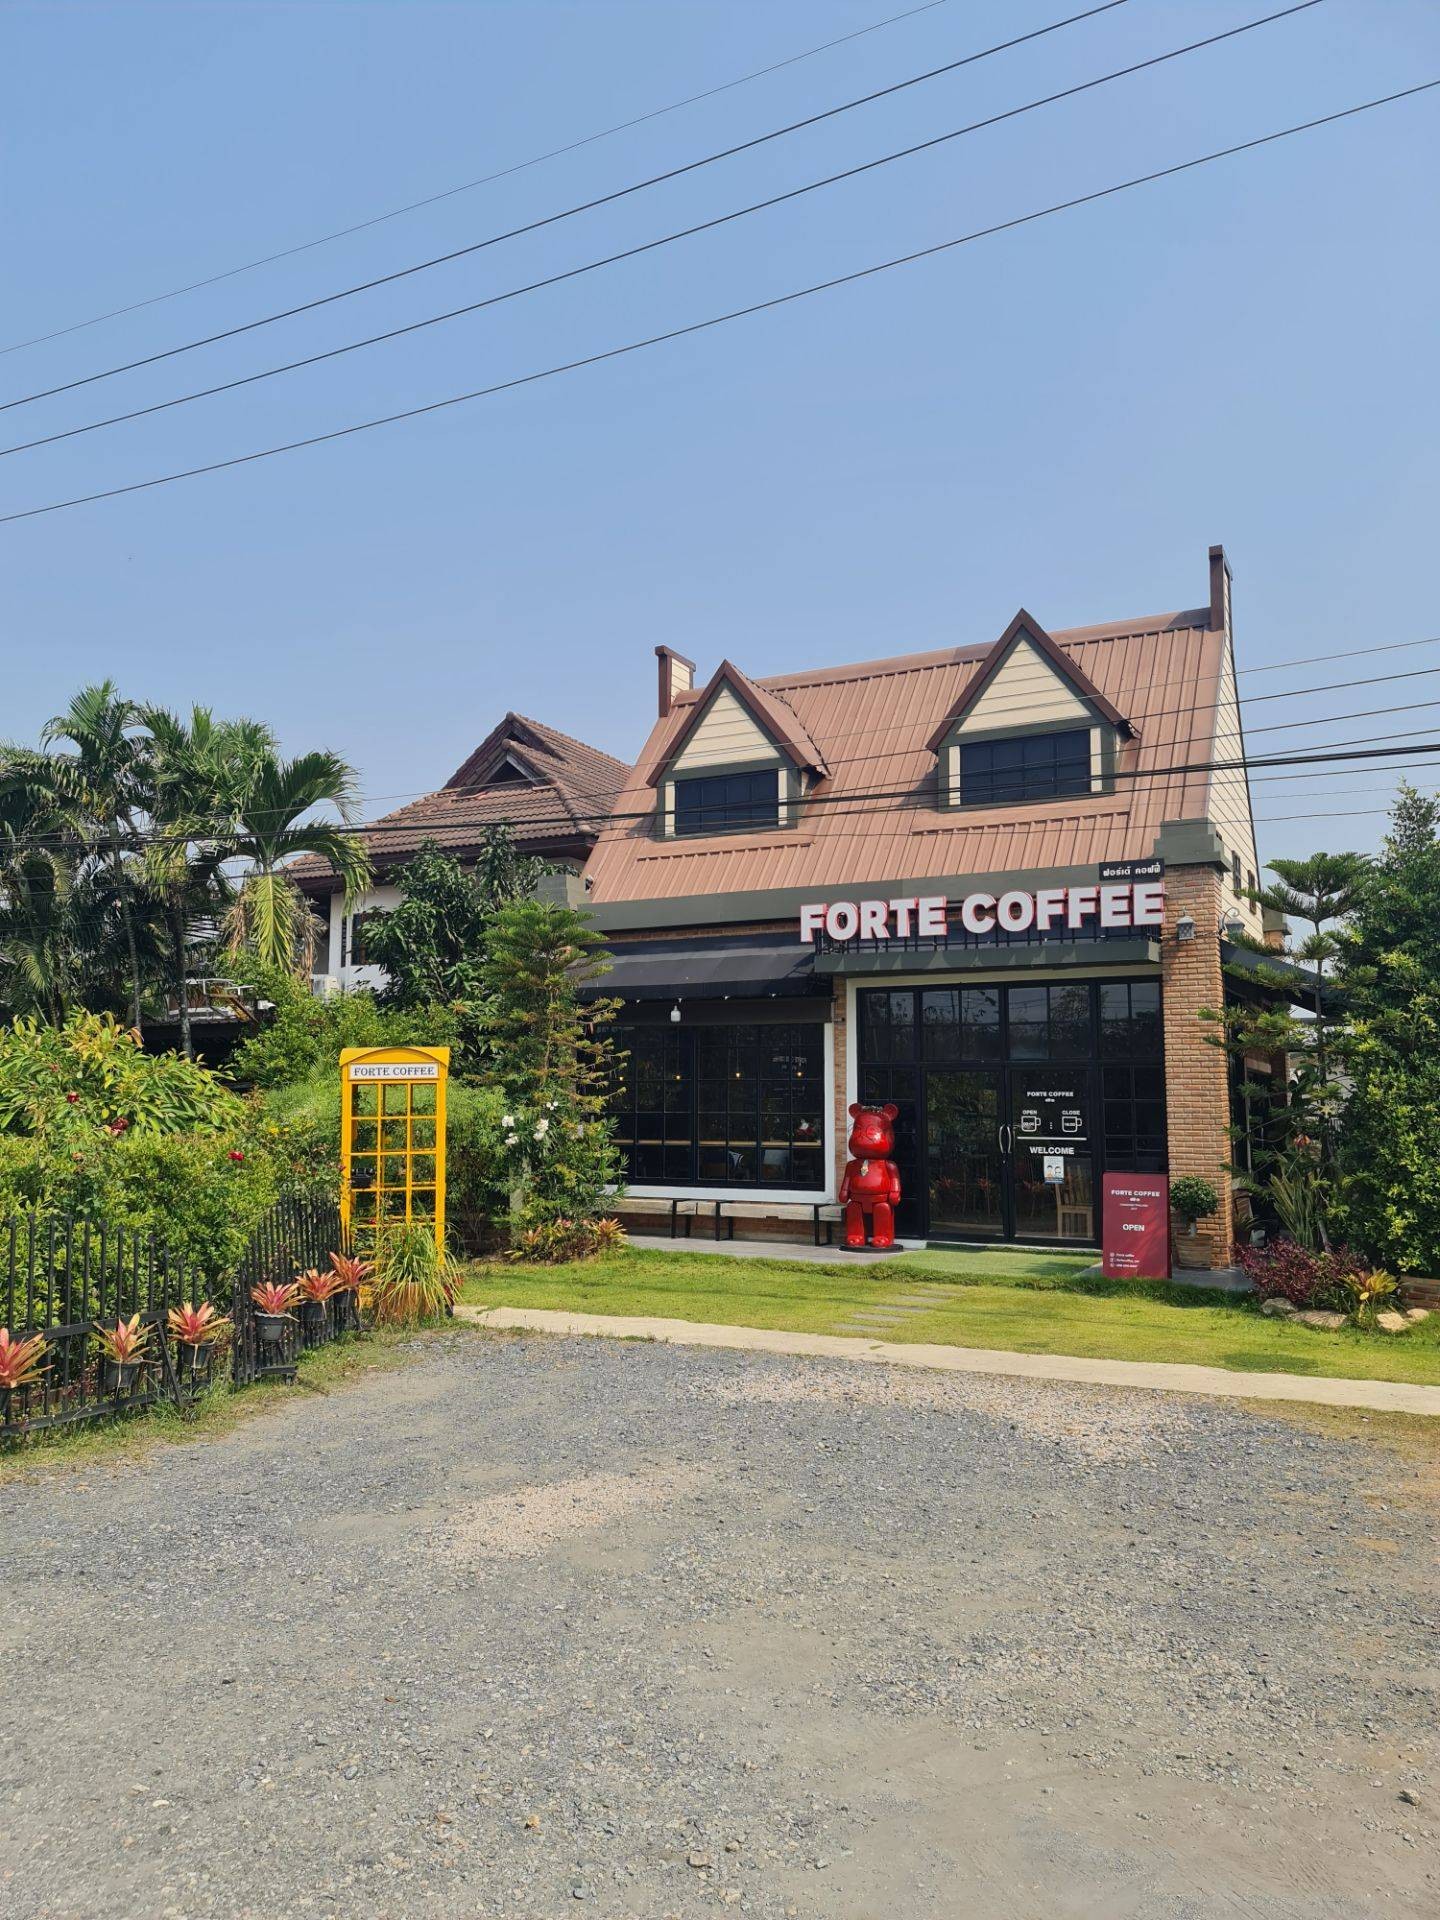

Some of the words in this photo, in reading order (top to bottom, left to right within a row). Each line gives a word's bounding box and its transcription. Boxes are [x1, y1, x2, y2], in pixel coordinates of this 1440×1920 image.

[801, 896, 947, 942] FORTE
[962, 881, 1165, 934] COFFEE
[354, 1067, 390, 1076] FORTE
[392, 1066, 435, 1076] COFFEE
[1029, 1146, 1075, 1154] WELCOME
[1122, 1224, 1145, 1232] OPEN
